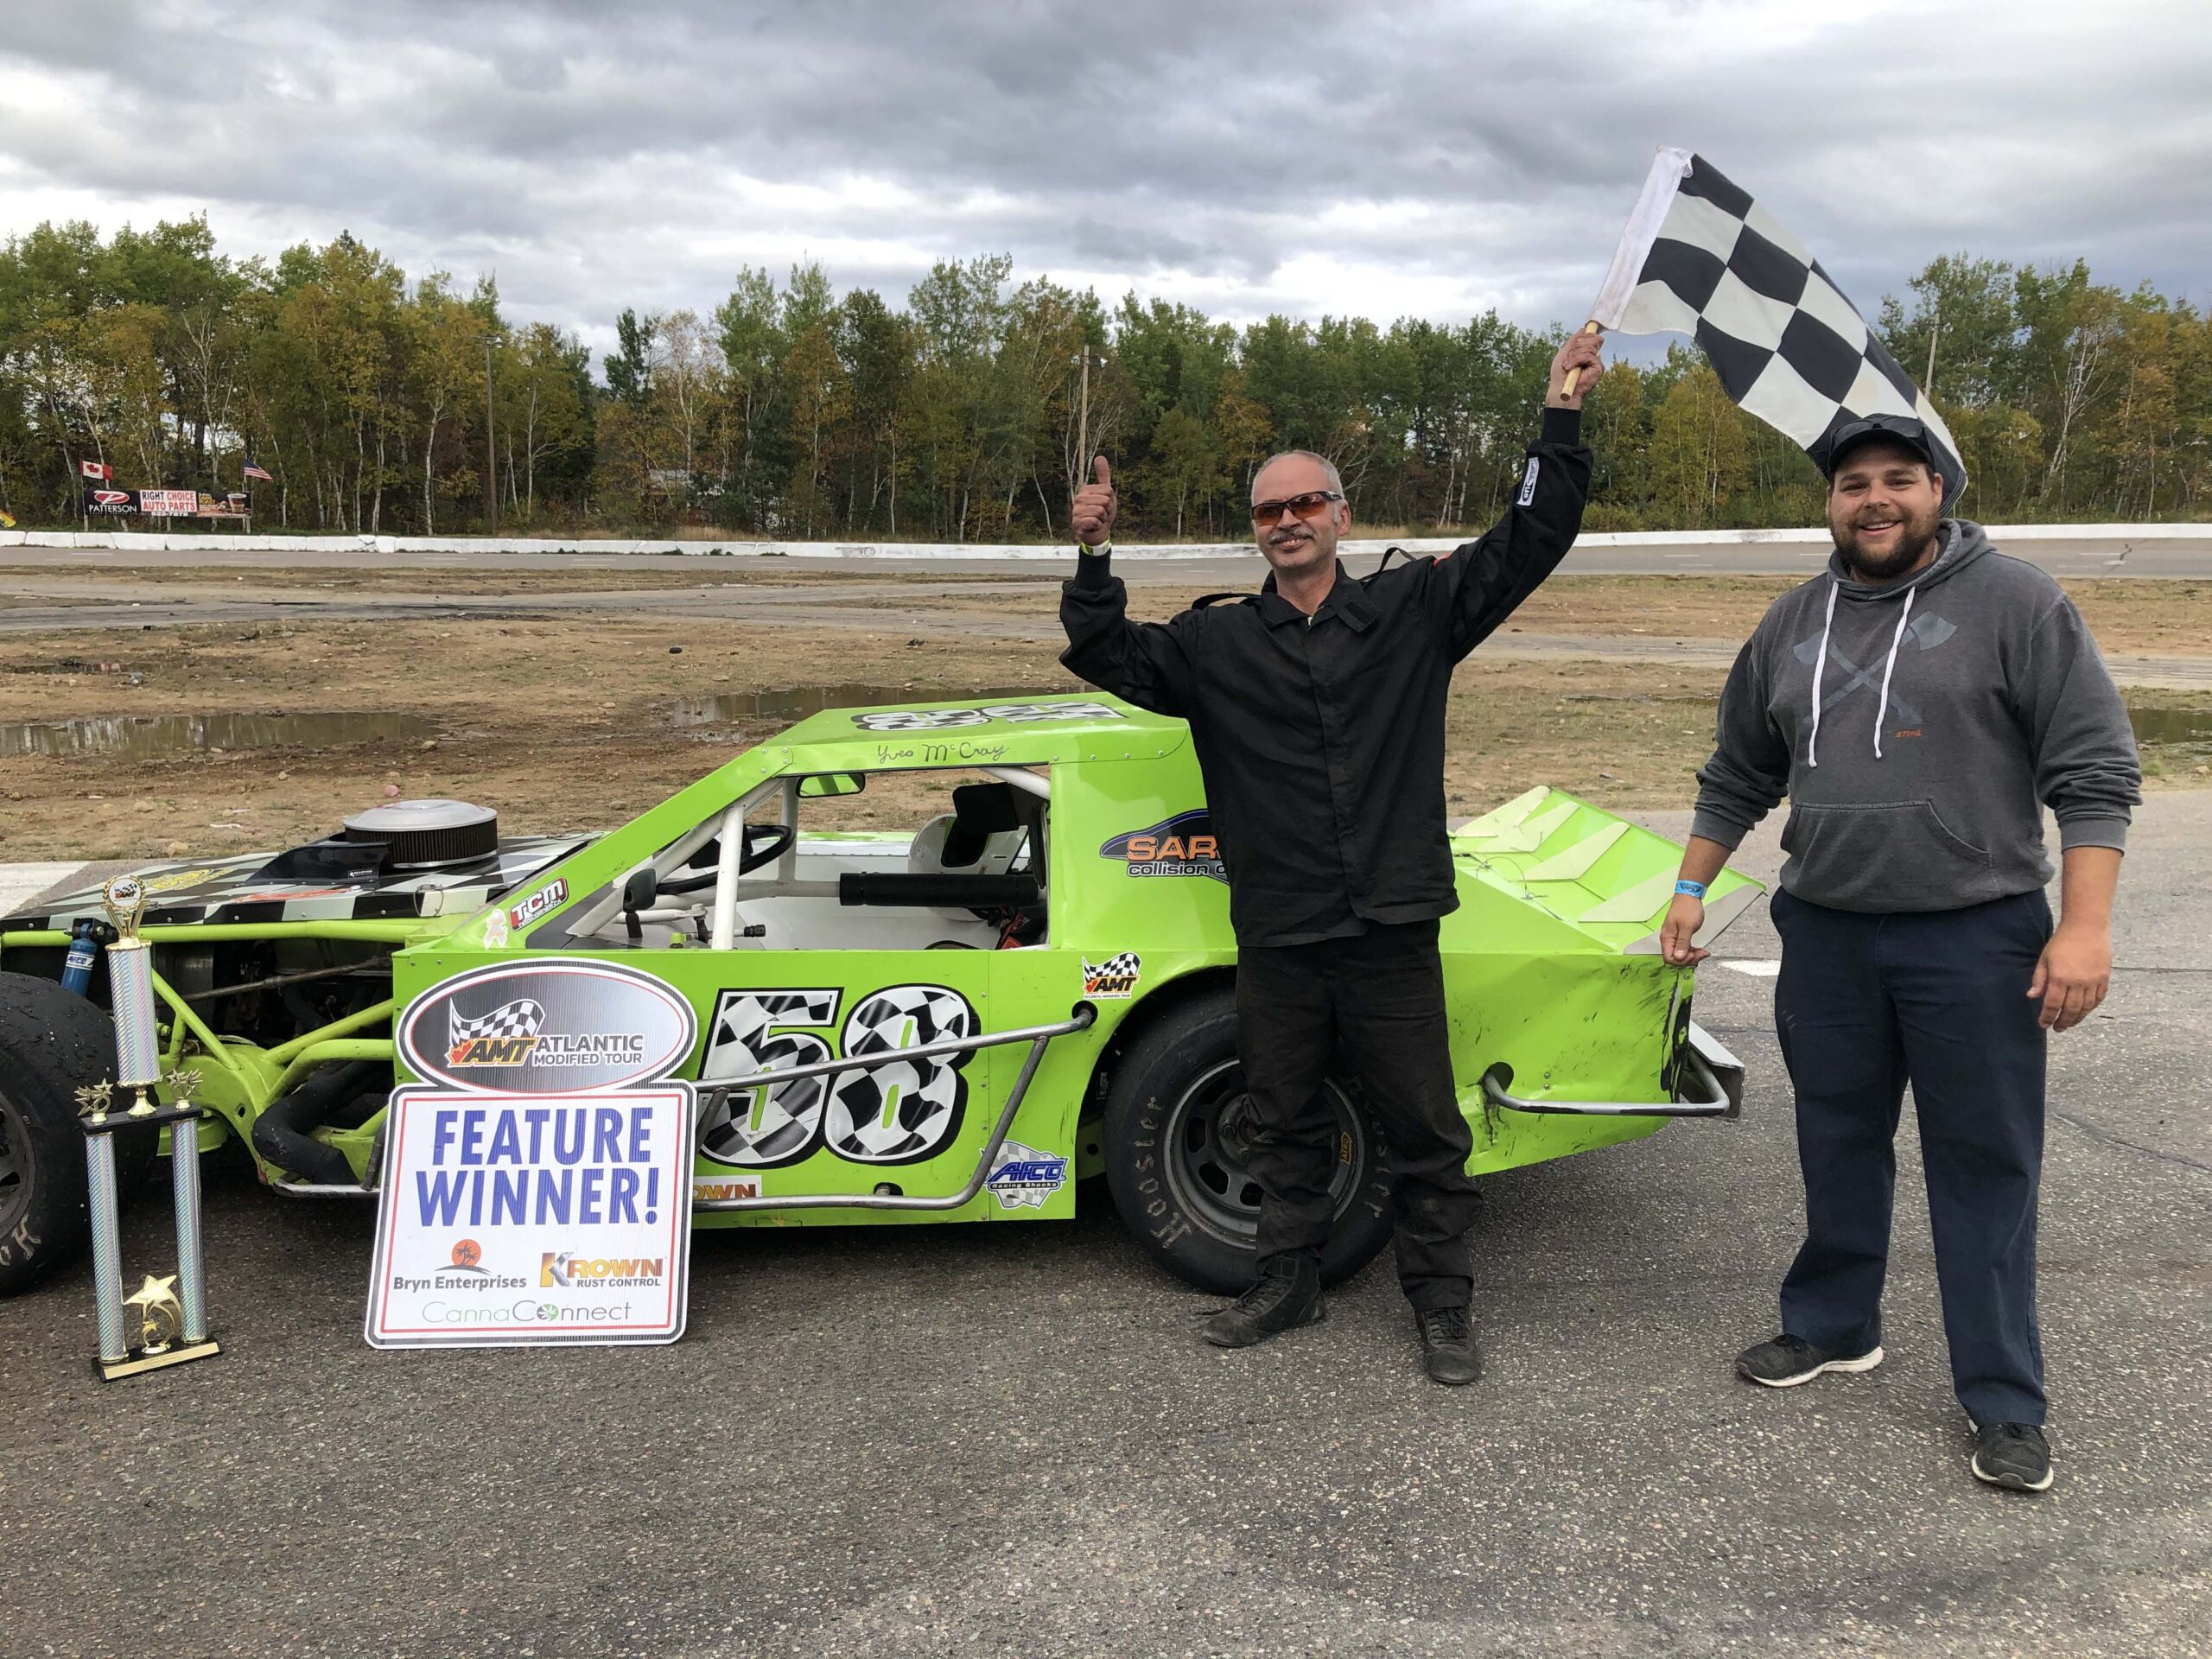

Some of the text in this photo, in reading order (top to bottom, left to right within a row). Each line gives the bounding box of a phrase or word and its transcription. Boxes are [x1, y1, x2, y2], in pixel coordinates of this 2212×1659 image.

[142, 492, 164, 500] RIGHT
[167, 492, 194, 501] CHOICE
[88, 504, 137, 512] PATTERSON
[168, 502, 195, 511] PARTS
[1126, 836, 1219, 861] SAR
[1128, 862, 1208, 875] collision
[1092, 976, 1138, 991] AMT
[462, 1035, 644, 1064] AMT ATLANTIC
[534, 1052, 642, 1065] MODIFIED TOUR
[697, 983, 981, 1169] 58
[432, 1107, 653, 1166] FEATURE
[986, 1160, 1065, 1182] AFCO
[416, 1167, 659, 1227] WINNER!
[693, 1184, 757, 1200] OWN
[393, 1274, 527, 1293] Bryn Enterprises
[576, 1278, 661, 1287] RUST CONTROL
